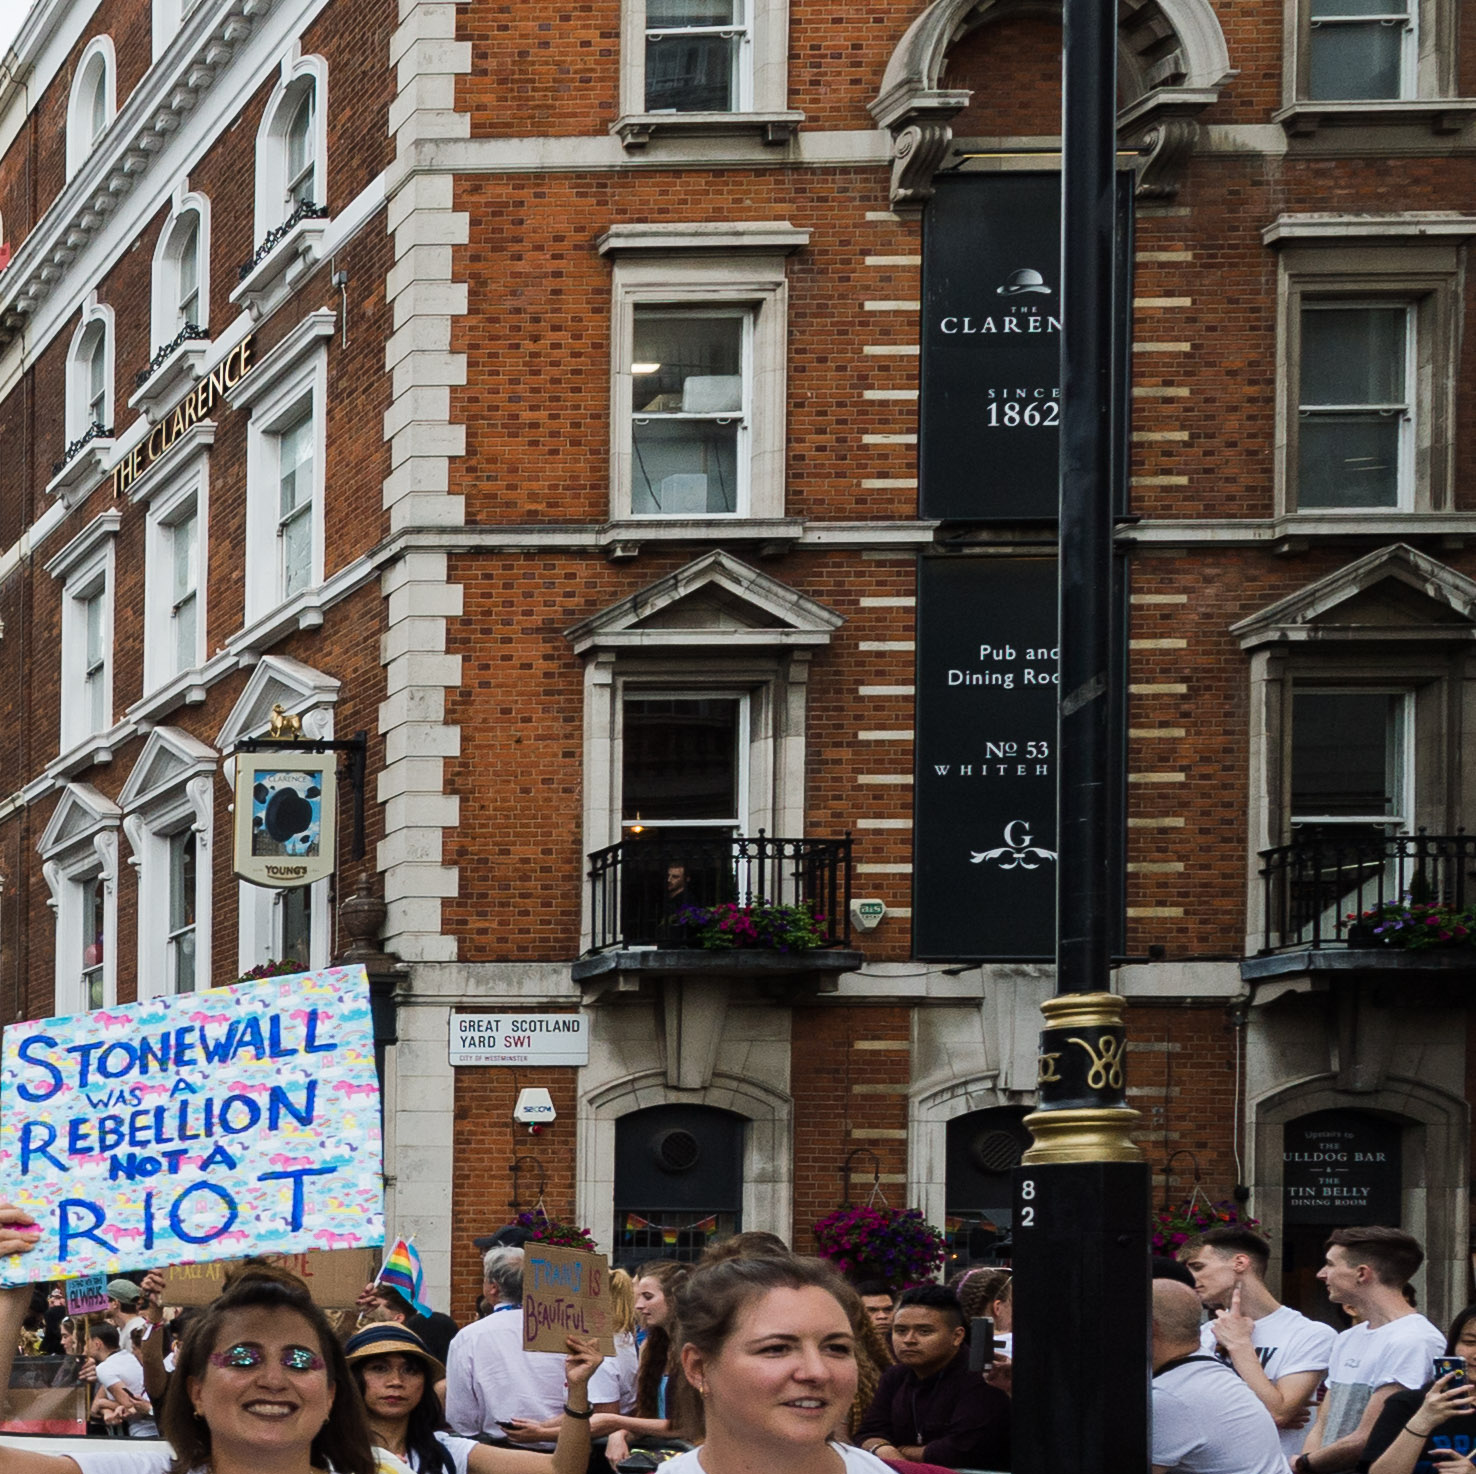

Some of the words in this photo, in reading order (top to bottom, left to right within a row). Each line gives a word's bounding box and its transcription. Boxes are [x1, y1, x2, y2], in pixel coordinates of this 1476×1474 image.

[940, 316, 1062, 334] CLAREN
[988, 388, 1061, 399] SINCE
[111, 442, 143, 499] THE
[149, 334, 252, 461] CLARENCE
[986, 401, 1060, 427] 1862
[979, 644, 1016, 660] Pub
[948, 669, 1015, 689] Dining
[1023, 668, 1059, 685] Roo
[1025, 741, 1049, 759] 53
[268, 775, 307, 783] CLARENCE
[934, 764, 1049, 776] WHITEH
[265, 864, 308, 876] YOUNG'S
[459, 1019, 502, 1033] GREAT
[511, 1019, 581, 1033] SCOTLAND
[460, 1035, 496, 1048] YARD
[504, 1035, 533, 1049] SW1
[17, 1007, 339, 1103] STONEWALL
[85, 1086, 142, 1110] WAS
[170, 1077, 197, 1099] A
[20, 1079, 318, 1176] REBELLION
[109, 1147, 188, 1181] NOT
[200, 1145, 237, 1170] A
[1282, 1152, 1348, 1162] ULLDOG
[1354, 1152, 1387, 1162] BAR
[1288, 1187, 1316, 1197] TIN
[1322, 1187, 1370, 1197] BELLY
[58, 1165, 338, 1262] RIOT
[530, 1258, 583, 1293] TRANS
[588, 1266, 601, 1297] IS
[525, 1293, 590, 1343] BEAUTIFUL
